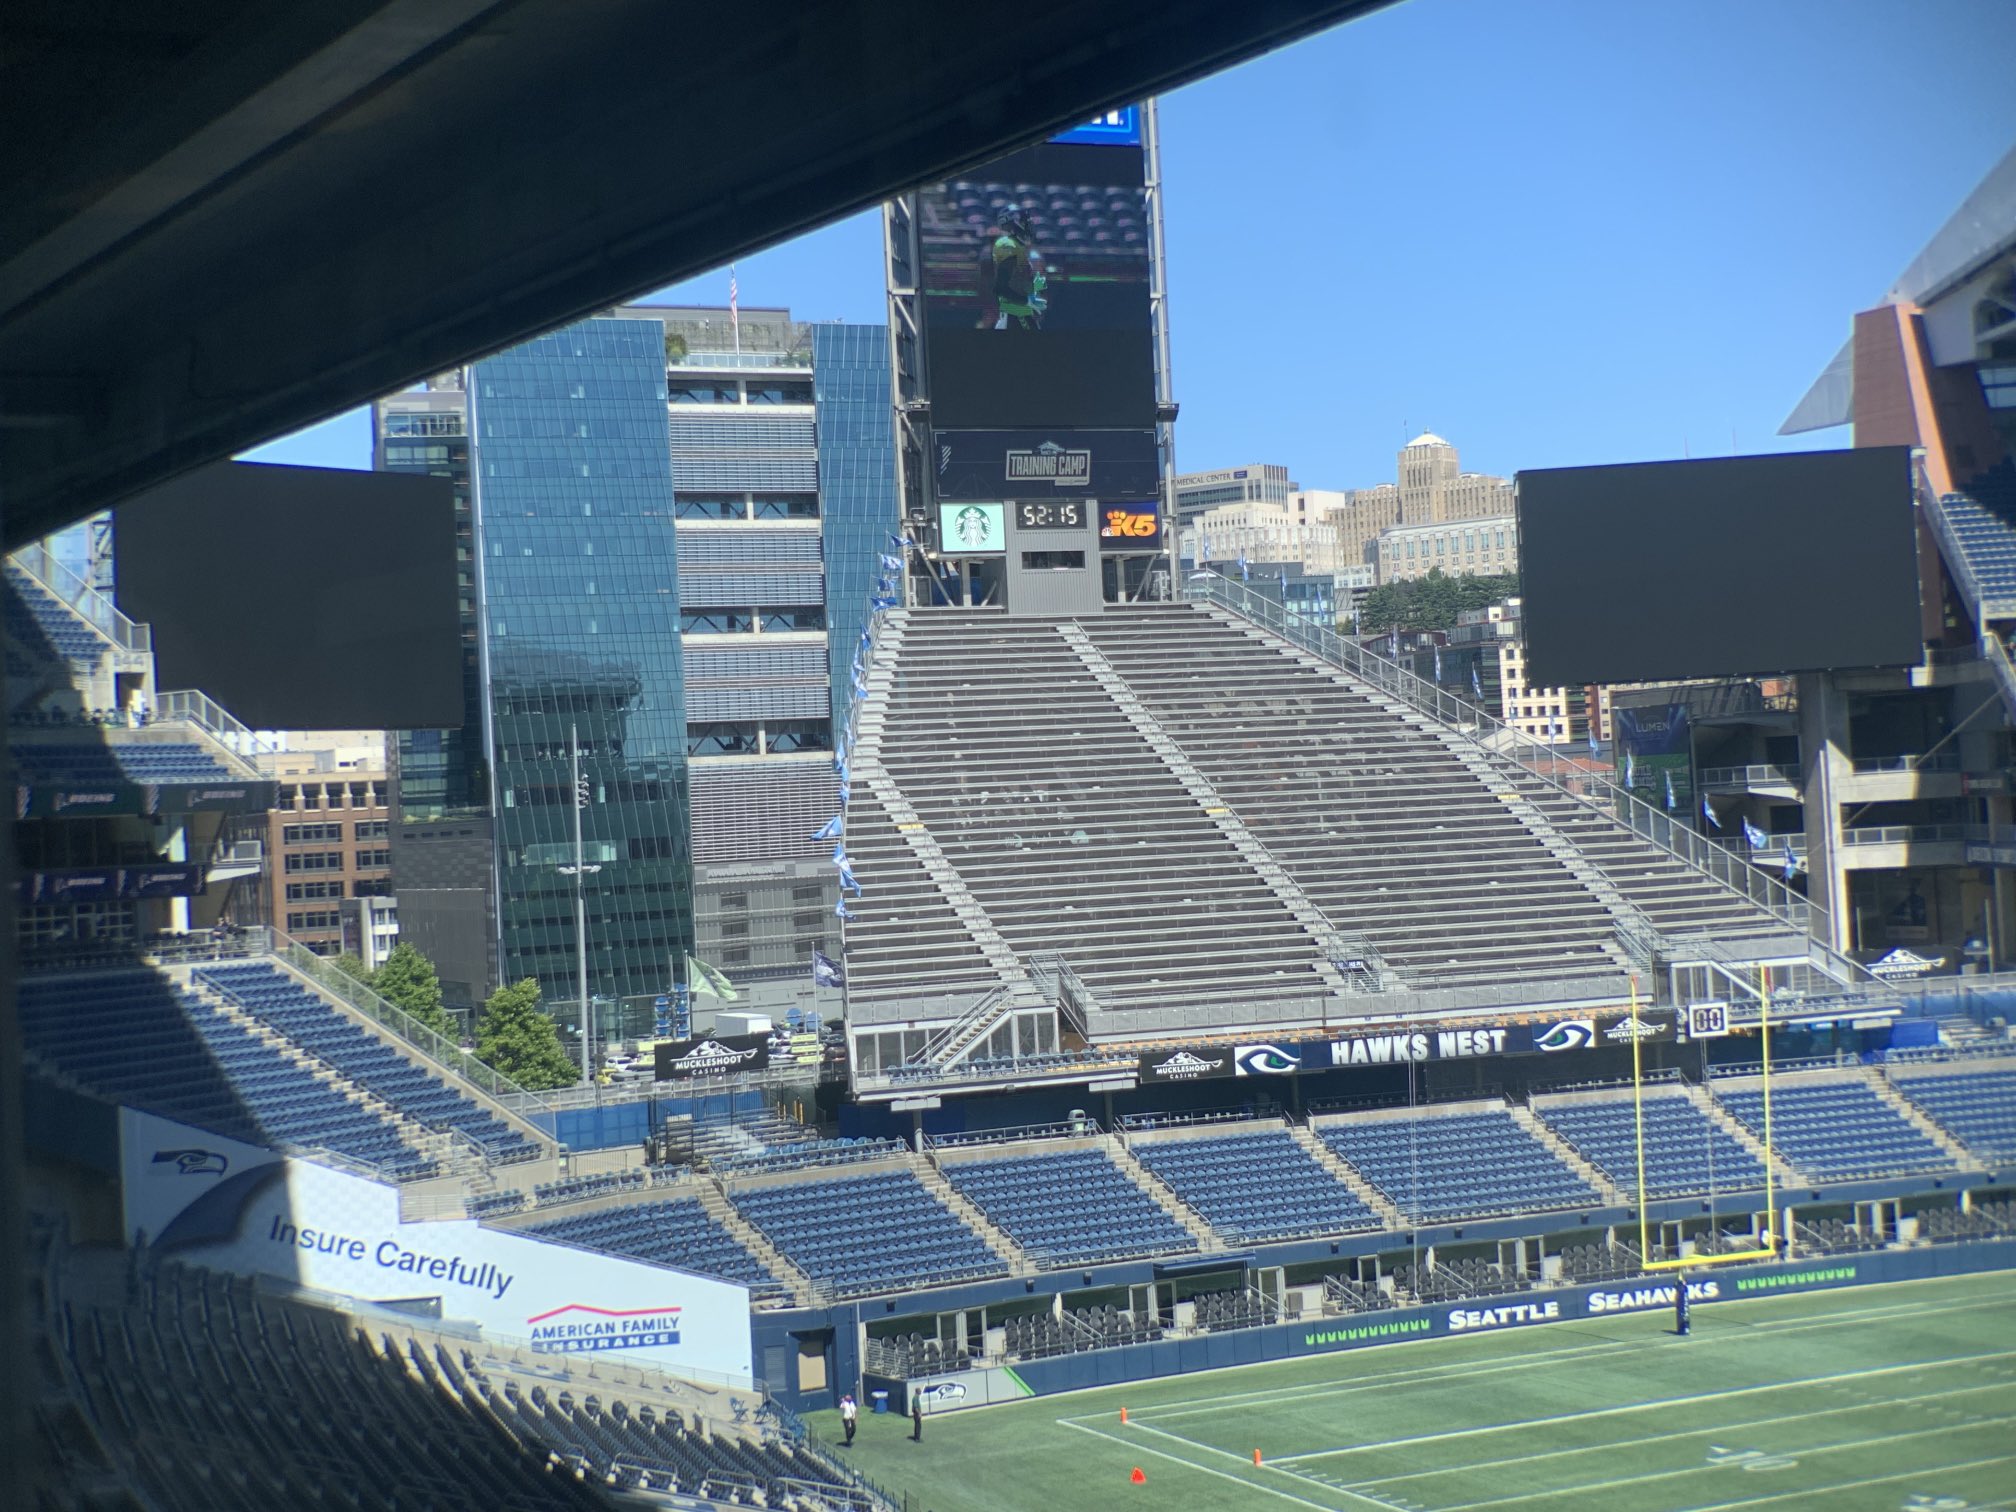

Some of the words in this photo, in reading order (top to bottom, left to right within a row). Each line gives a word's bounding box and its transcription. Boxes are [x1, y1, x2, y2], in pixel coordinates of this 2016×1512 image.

[1010, 456, 1056, 476] TRAINING
[1058, 455, 1085, 475] CAMP
[1176, 475, 1204, 486] MEDICAL
[1206, 472, 1231, 483] CENTER
[1023, 505, 1078, 526] 52:15
[1635, 721, 1670, 733] LUMEN
[1695, 1008, 1722, 1032] 00
[1607, 1028, 1656, 1039] MUCKLEHOOT
[1331, 1033, 1428, 1064] HAWKS
[1438, 1029, 1506, 1058] NEST
[675, 1055, 743, 1070] MUCKLESHOOT
[692, 1066, 726, 1076] CASINO
[1156, 1063, 1211, 1075] MUCKLESHOOT
[270, 1215, 366, 1260] Insure
[375, 1241, 514, 1299] Carefully
[1448, 1301, 1559, 1330] SEATTLE
[531, 1321, 616, 1340] AMERICAN
[622, 1316, 680, 1333] FAMILY
[543, 1333, 670, 1352] INSURANCE
